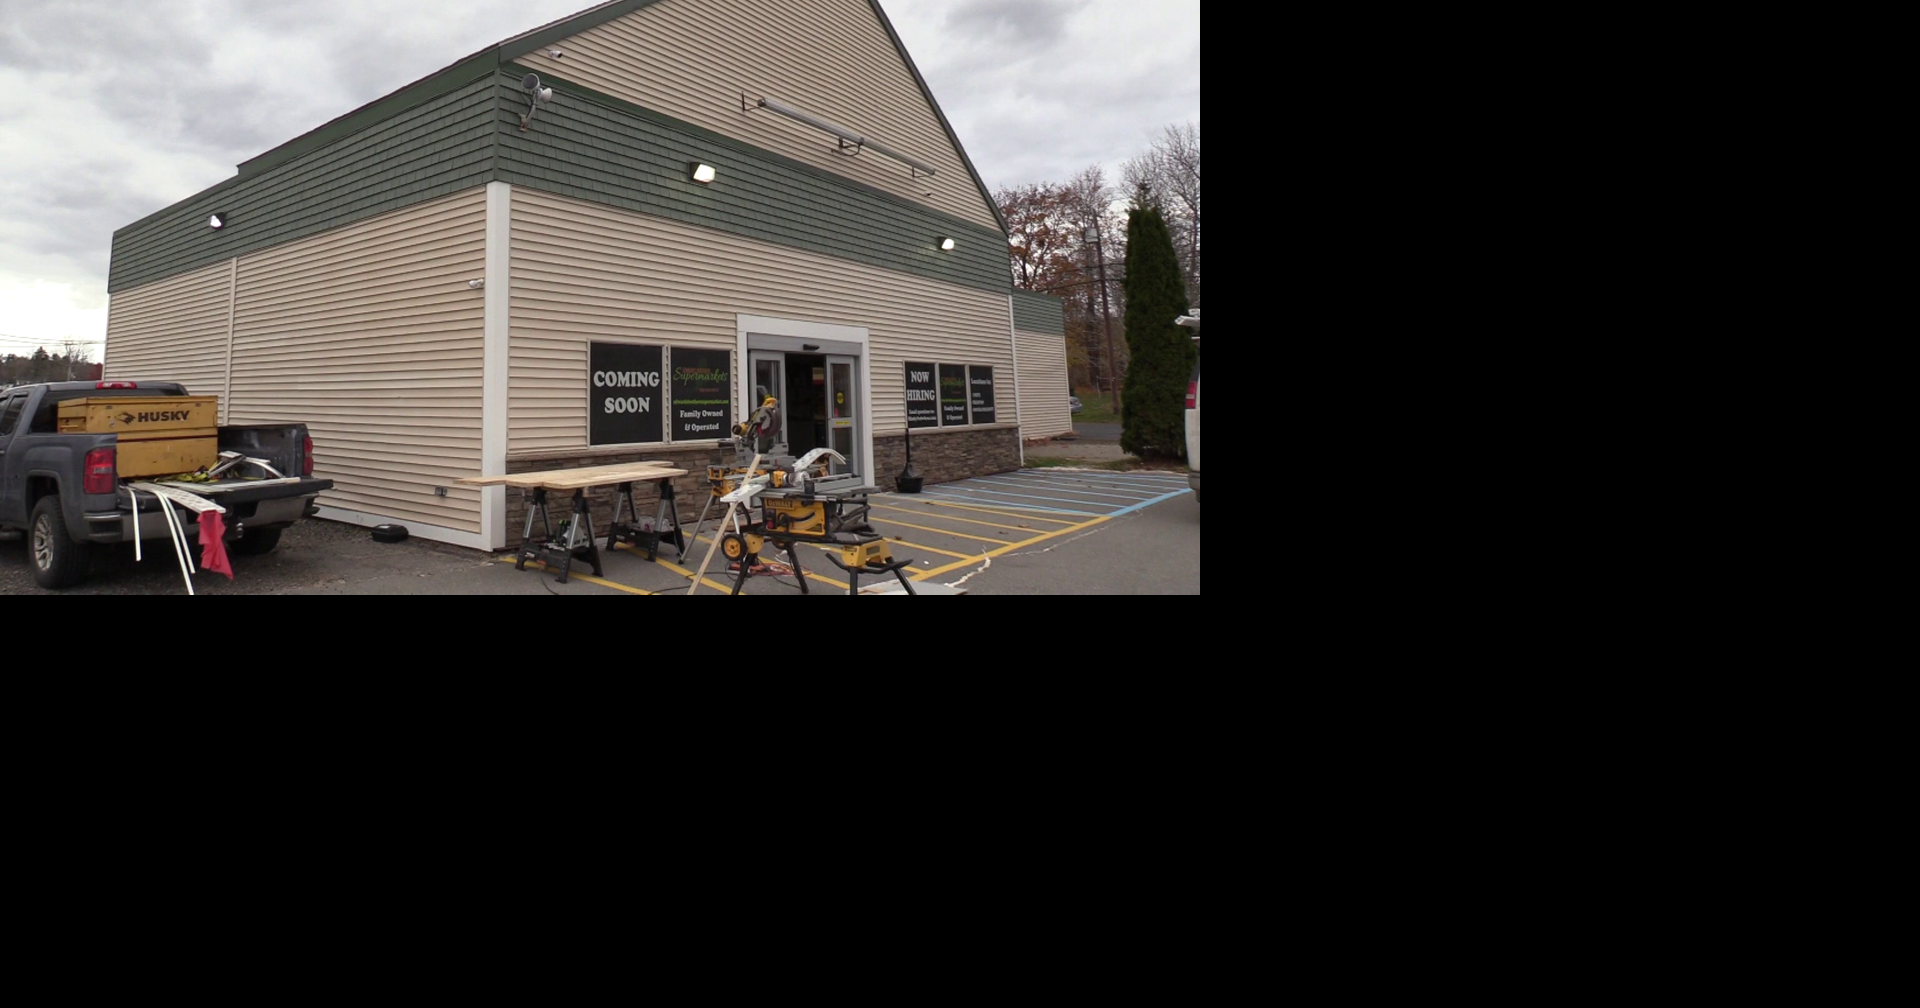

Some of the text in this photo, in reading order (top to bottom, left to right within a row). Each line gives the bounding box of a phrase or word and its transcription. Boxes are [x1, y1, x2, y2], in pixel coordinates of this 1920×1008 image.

[593, 371, 660, 388] COMING
[673, 367, 728, 386] Supermarkets
[910, 371, 930, 383] NOW
[907, 389, 935, 401] HIRING
[604, 397, 650, 414] SOON
[138, 410, 190, 422] HUSKY
[680, 410, 701, 419] Family
[691, 423, 719, 432] Operated
